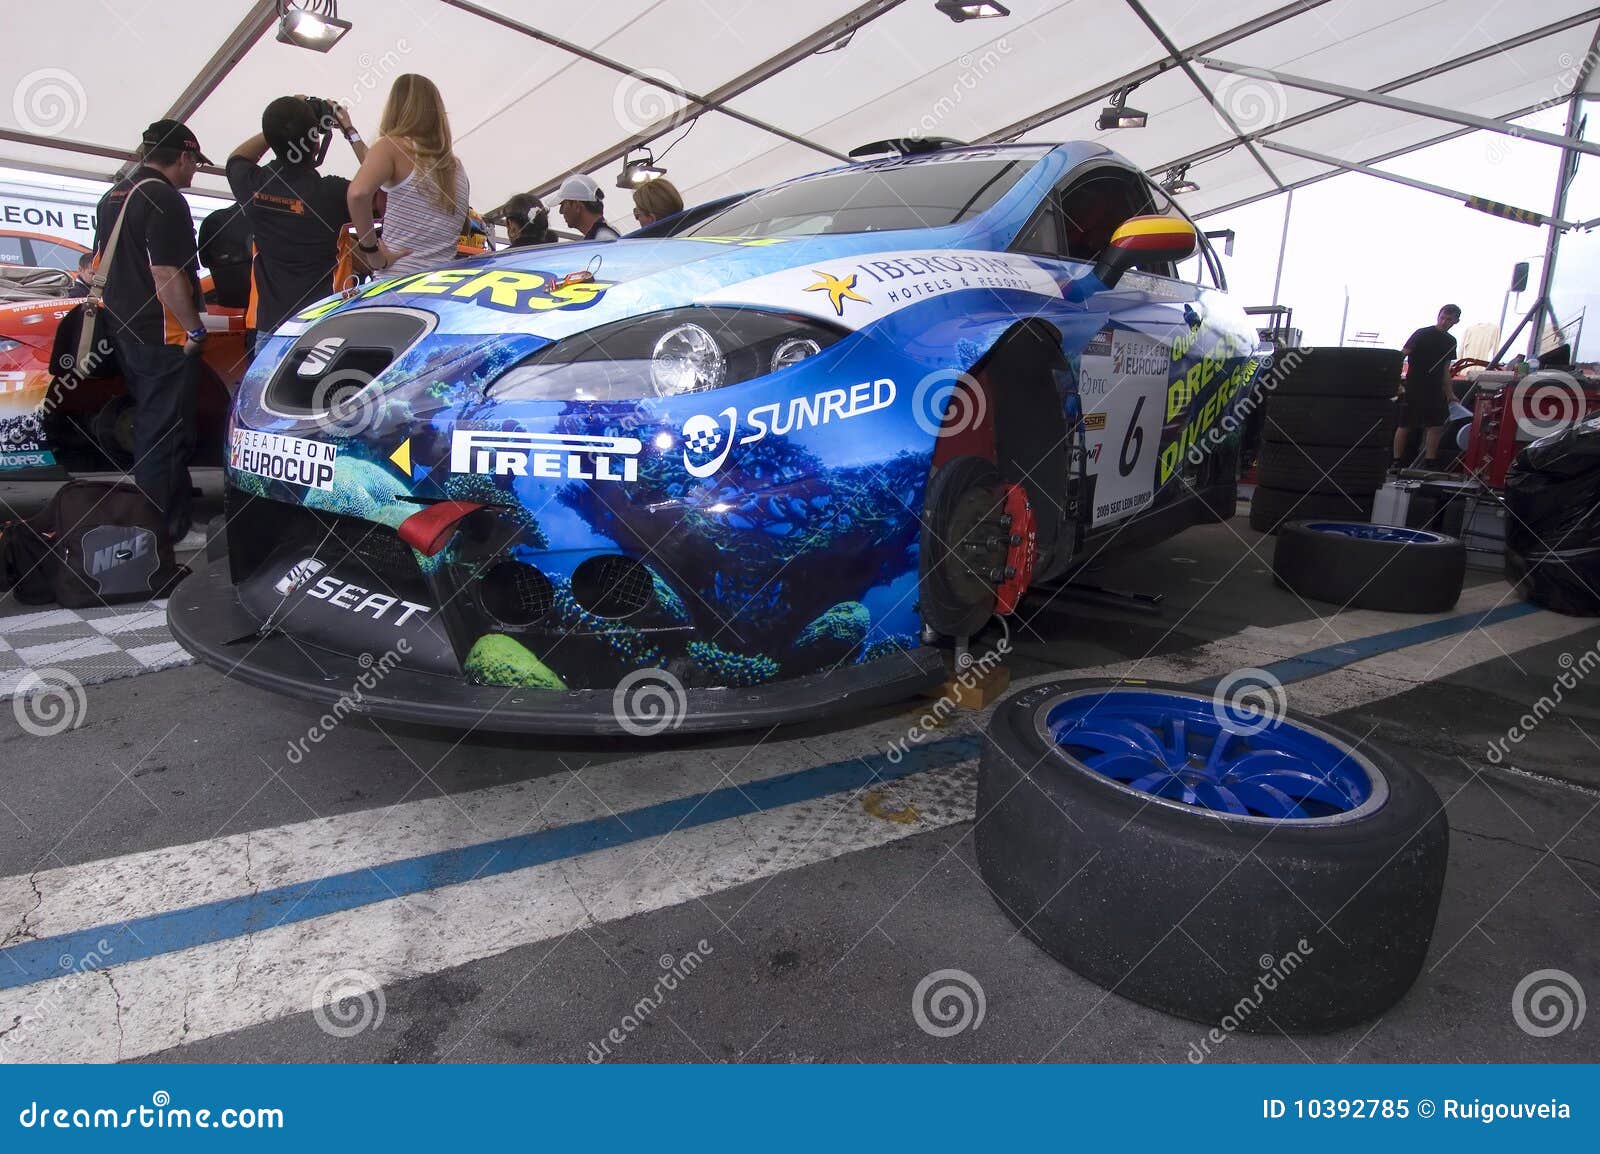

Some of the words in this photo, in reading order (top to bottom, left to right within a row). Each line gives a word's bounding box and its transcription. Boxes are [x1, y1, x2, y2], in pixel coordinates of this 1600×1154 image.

[0, 205, 64, 228] EON
[857, 256, 1027, 282] IBEROSTAR
[888, 278, 952, 303] HOTELS
[960, 277, 970, 286] &
[1126, 357, 1168, 376] EUROCUP
[740, 378, 897, 444] SUNRED
[1160, 364, 1242, 486] DIVERS
[450, 429, 643, 482] PIRELLI
[1118, 395, 1146, 477] 6
[0, 454, 47, 466] TOREX
[242, 449, 334, 488] EUROCUP
[90, 534, 151, 576] NIKE
[306, 575, 431, 627] SEAT
